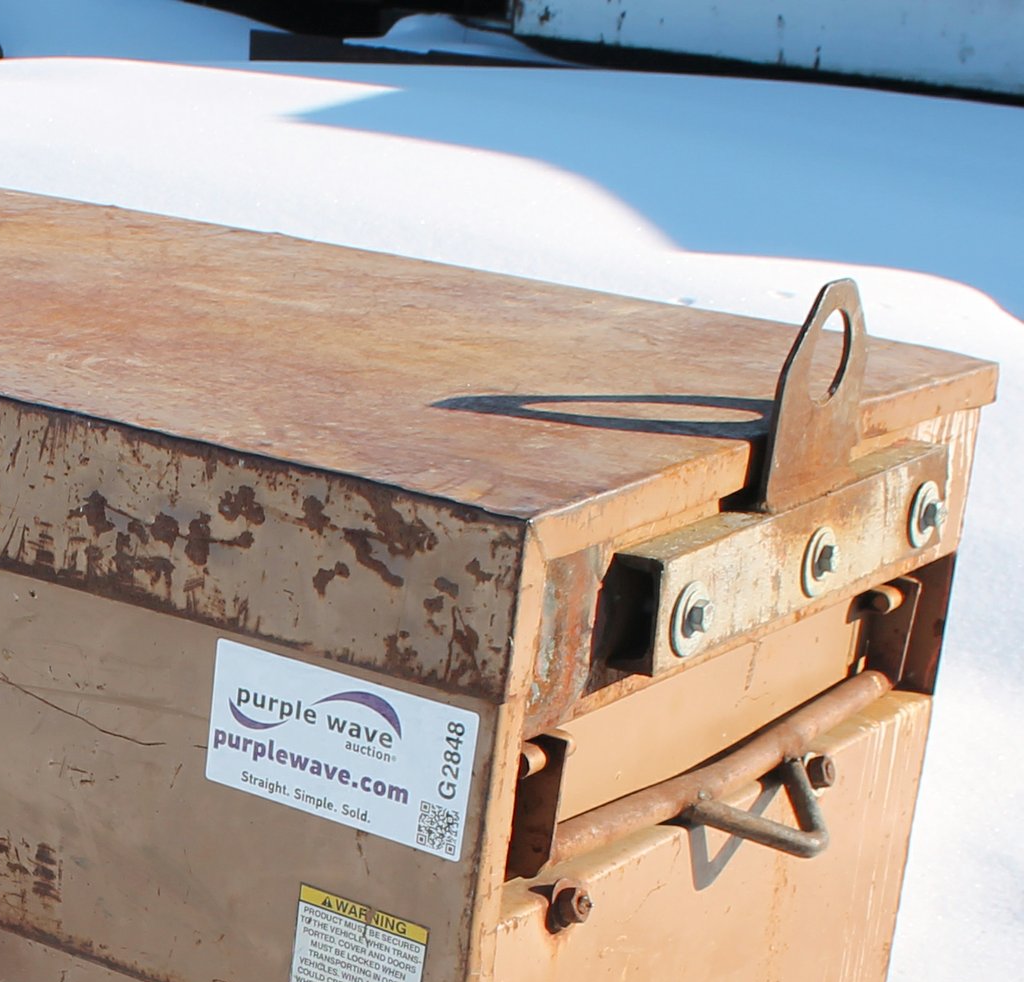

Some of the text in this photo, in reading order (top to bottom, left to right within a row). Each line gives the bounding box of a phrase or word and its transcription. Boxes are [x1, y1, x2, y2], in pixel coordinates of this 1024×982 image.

[237, 687, 393, 749] purple wave
[213, 729, 409, 804] purplewave.com
[438, 721, 466, 800] G2848
[241, 771, 371, 823] Straight. Simple. Sold.
[304, 906, 343, 926] PRODUCT
[369, 929, 380, 940] BE
[382, 934, 421, 954] SECURED
[313, 919, 329, 931] THE
[330, 926, 364, 944] VEHICLE
[365, 938, 391, 954] WHEN
[392, 948, 422, 965] TRANS-
[297, 966, 326, 982] COULD
[309, 949, 372, 978] TRANSPORTING
[372, 972, 381, 982] IN
[310, 940, 406, 981] MUST BE LOCKED WHEN
[338, 939, 368, 955] COVER
[368, 950, 386, 962] AND
[387, 957, 417, 974] DOORS
